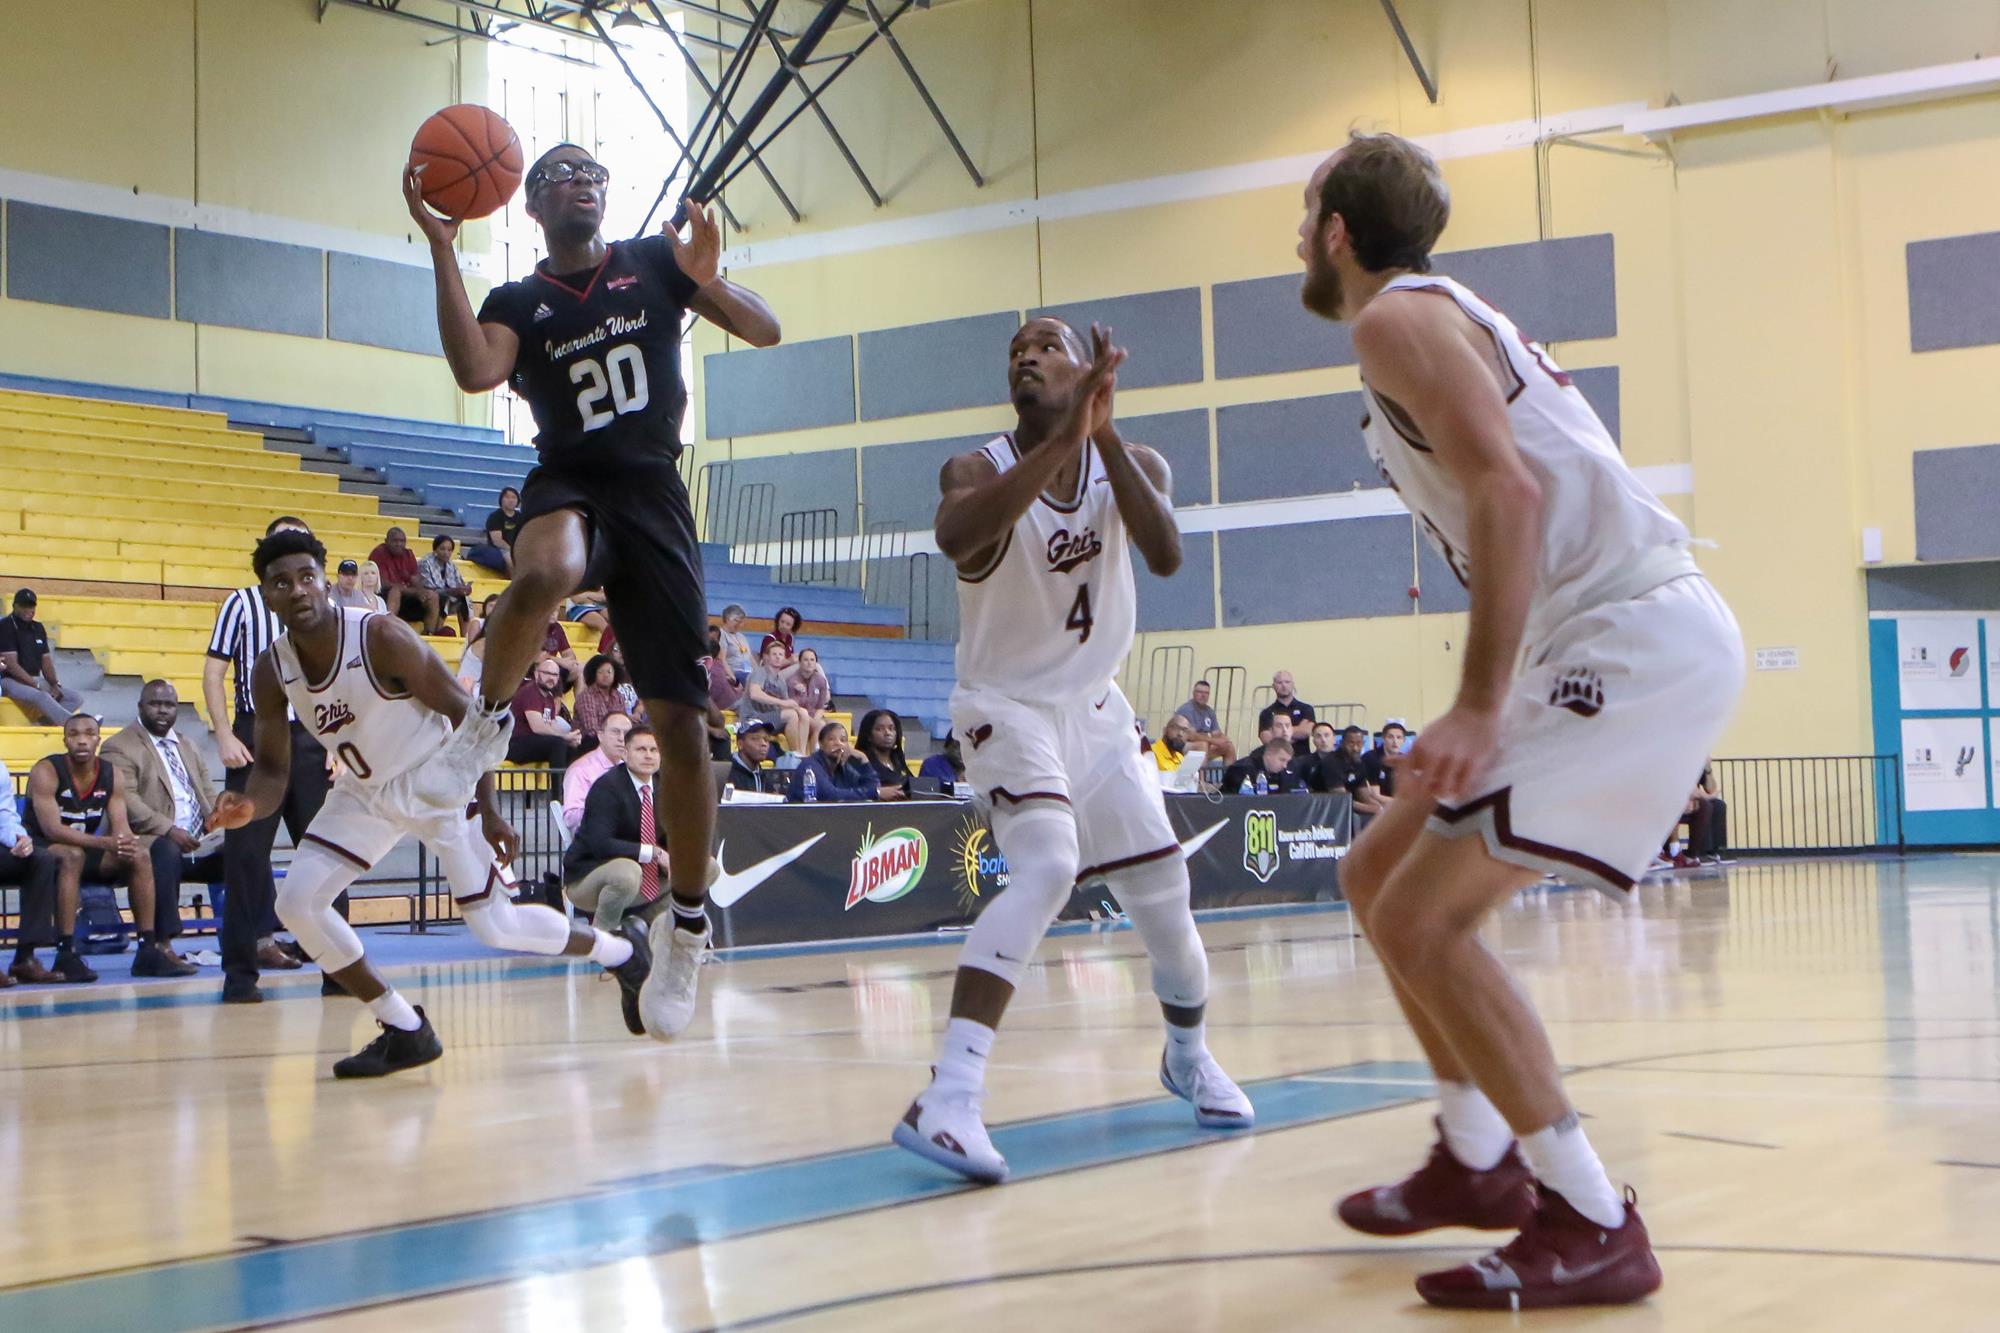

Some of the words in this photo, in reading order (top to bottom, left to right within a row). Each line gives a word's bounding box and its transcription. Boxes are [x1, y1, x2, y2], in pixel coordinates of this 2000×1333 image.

[545, 326, 607, 361] Incarnate
[606, 309, 648, 336] Word
[569, 343, 649, 432] 20
[1065, 582, 1093, 645] 4
[337, 741, 372, 779] 0
[1247, 815, 1274, 854] 811
[1289, 841, 1305, 860] Call
[846, 838, 921, 908] LIBMAN
